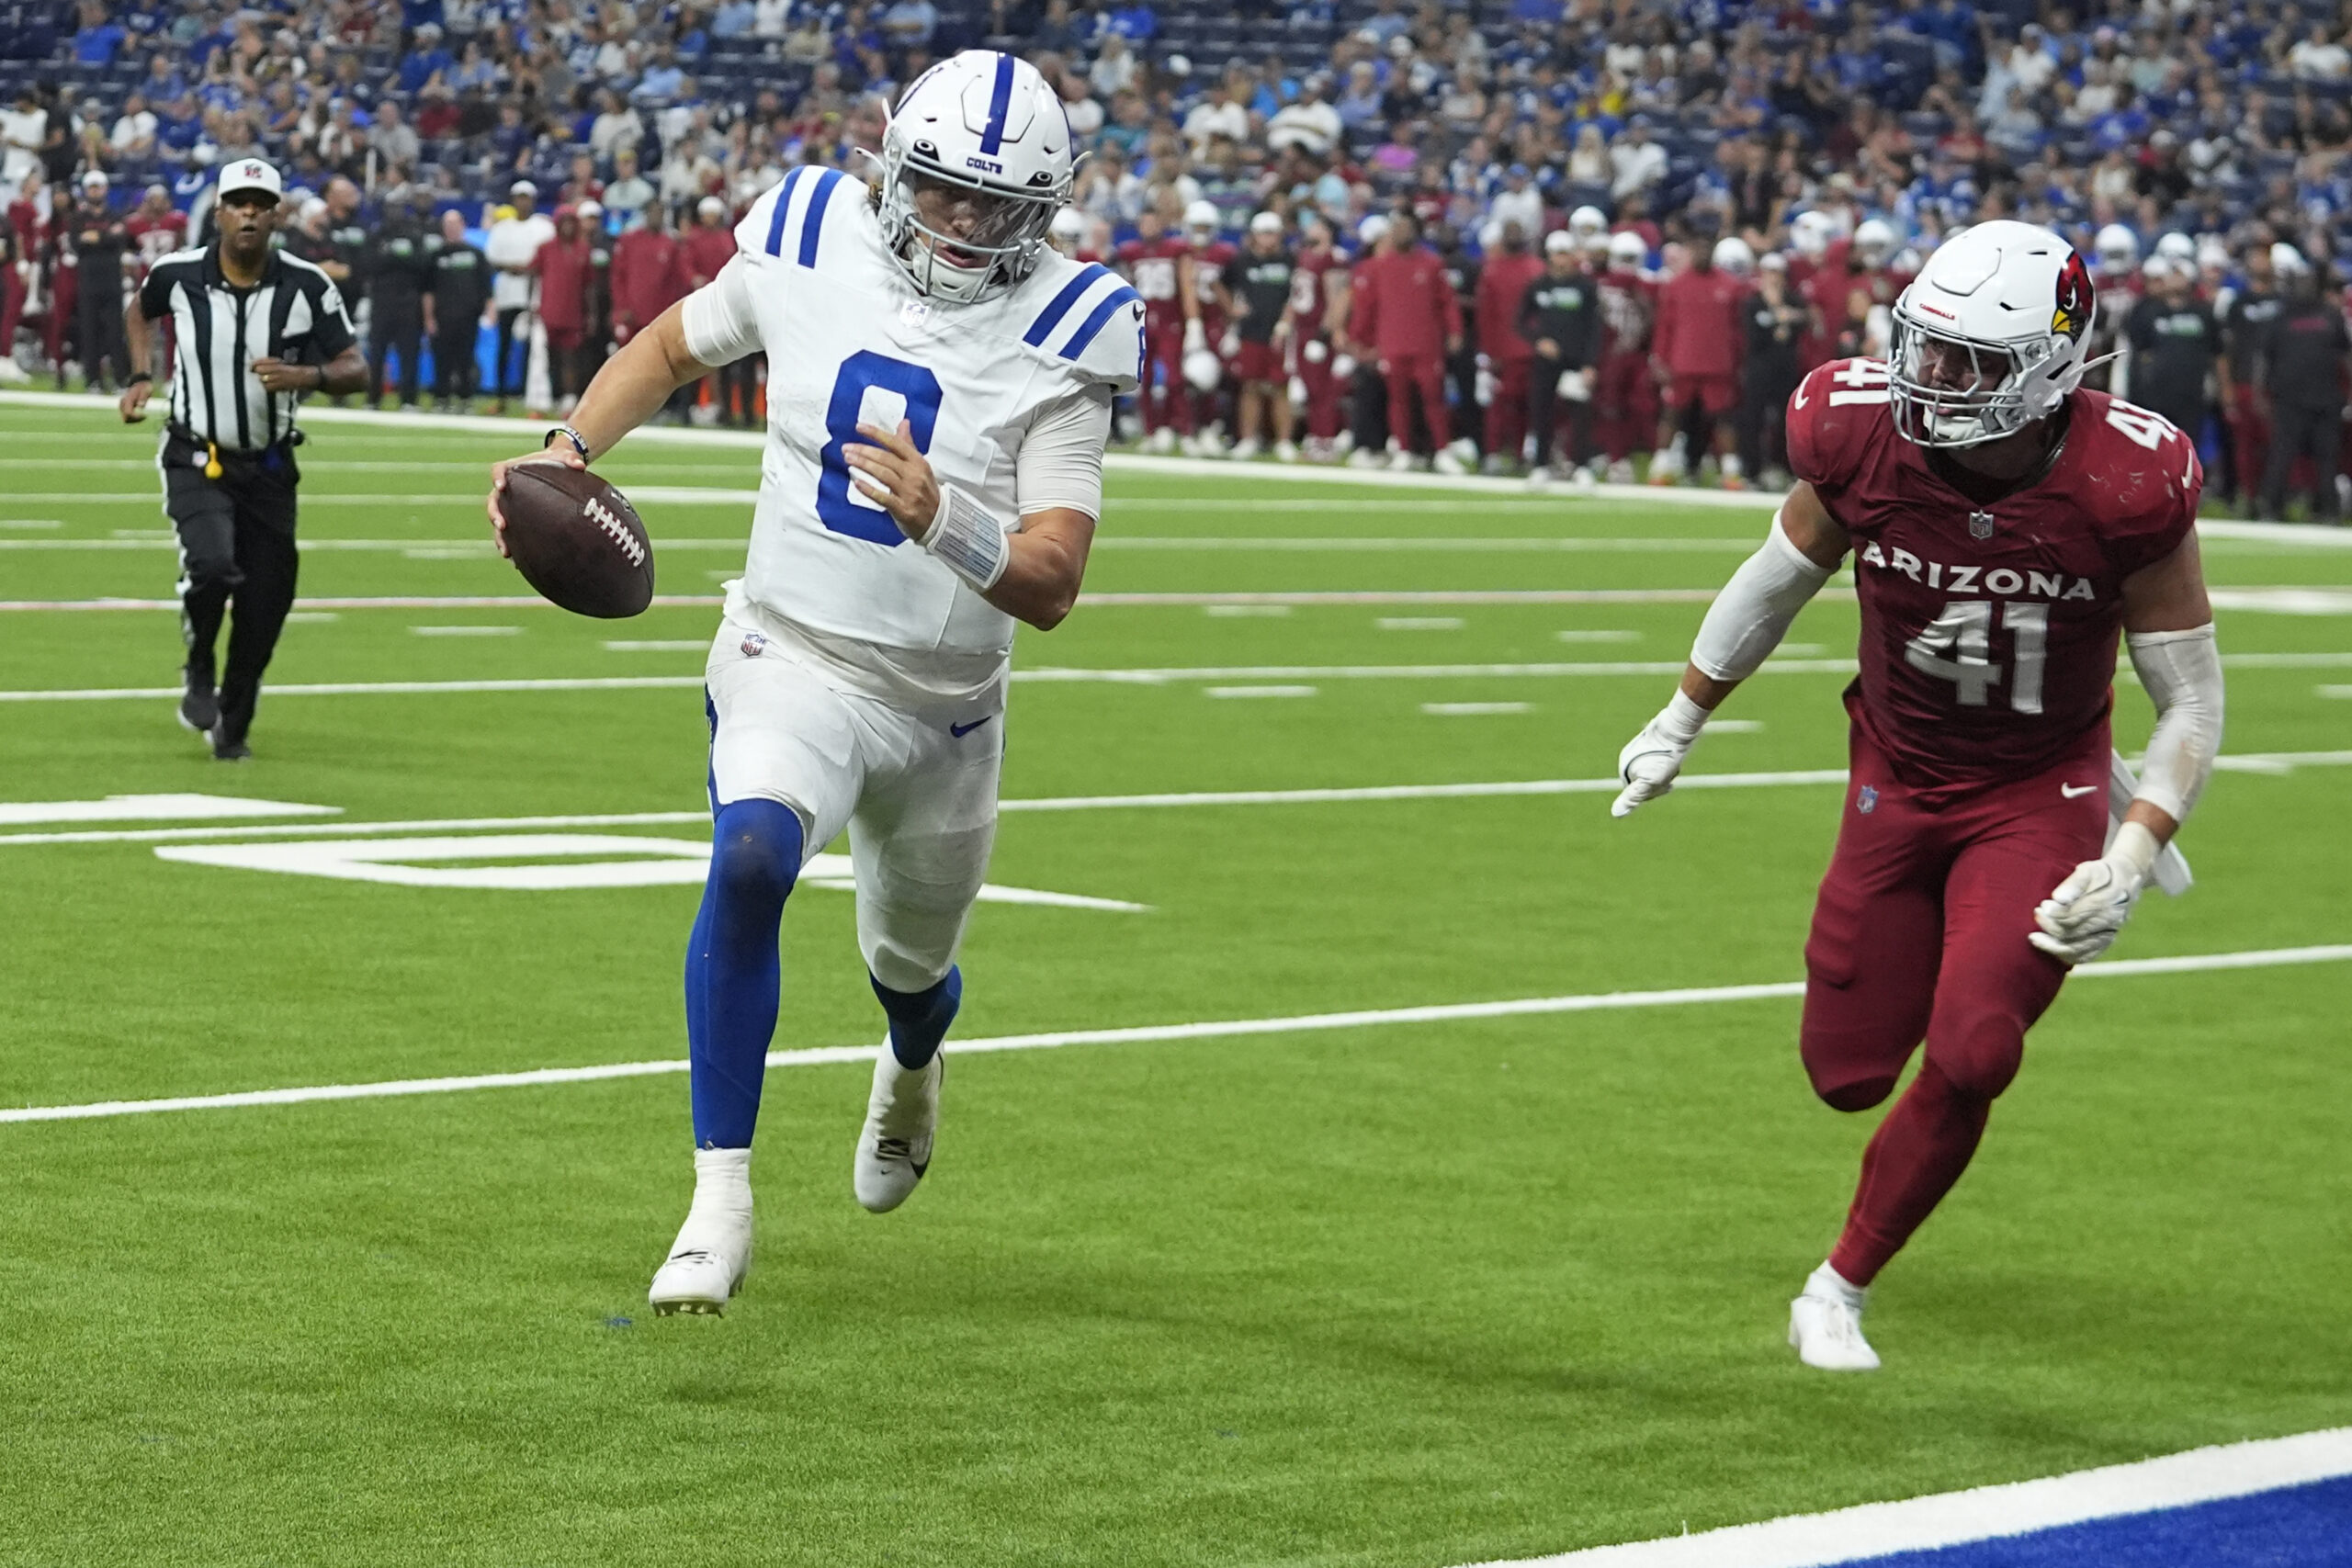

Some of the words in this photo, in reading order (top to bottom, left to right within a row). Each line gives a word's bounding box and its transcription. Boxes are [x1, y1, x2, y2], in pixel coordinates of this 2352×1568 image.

[967, 156, 1002, 175] COLTS
[1829, 358, 1900, 407] 41
[815, 349, 944, 547] 8
[2105, 398, 2178, 451] 41
[1861, 540, 2095, 600] ARIZONA
[1904, 601, 2050, 714] 41
